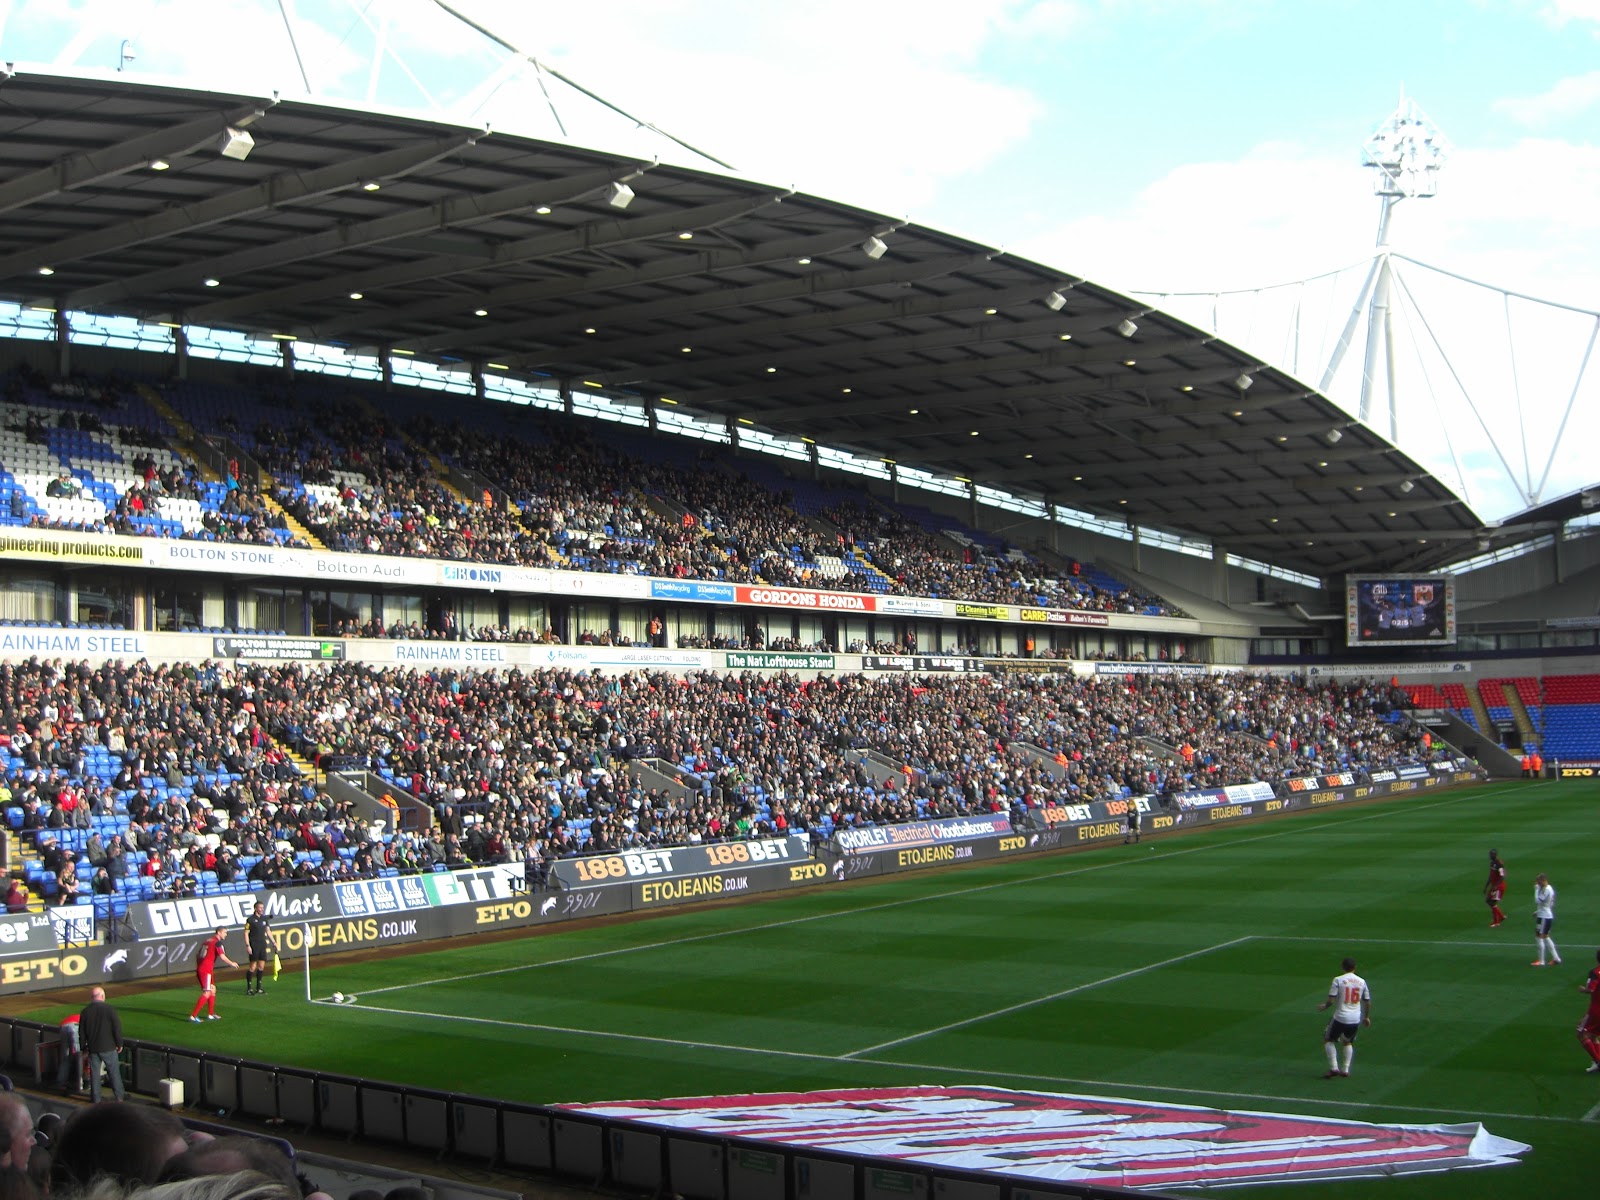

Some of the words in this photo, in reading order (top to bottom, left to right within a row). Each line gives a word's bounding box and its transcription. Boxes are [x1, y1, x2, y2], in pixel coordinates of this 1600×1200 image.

[62, 542, 143, 559] products.com
[170, 547, 226, 560] BOLTON
[231, 551, 274, 564] STONE
[317, 560, 368, 574] Bolton
[750, 589, 816, 607] GORDONS
[819, 594, 865, 610] HONDA
[965, 605, 987, 615] Cleaning
[988, 607, 998, 615] Ltd
[1021, 610, 1046, 621] CARRS
[1046, 612, 1066, 622] Pasties
[87, 637, 144, 653] STEEL
[230, 639, 266, 648] BOLTON
[268, 640, 321, 650] WANDERERS
[241, 648, 278, 658] AGAINST
[280, 649, 312, 658] RACISM
[396, 646, 461, 660] RAINHAM
[465, 647, 504, 662] STEEL
[728, 655, 747, 667] The
[749, 655, 763, 667] Nat
[765, 656, 808, 668] Lofthouse
[809, 657, 833, 668] Stand
[879, 657, 914, 667] WILSON
[932, 658, 965, 668] WILSON
[1562, 768, 1593, 777] ETO
[1106, 797, 1152, 816] 188ET
[1265, 800, 1282, 811] ETO
[1041, 804, 1093, 824] 188BET
[1153, 815, 1173, 828] ETO
[840, 827, 889, 848] CHORLEY
[890, 825, 931, 843] Electrical
[1000, 836, 1026, 851] ETO
[706, 838, 790, 867] 188BET
[575, 851, 673, 881] 188BET
[790, 863, 827, 881] ETO
[267, 891, 323, 917] Mart
[344, 904, 367, 915] YARA
[376, 901, 397, 911] YARA
[406, 897, 427, 907] YARA
[476, 901, 532, 924] ETO
[31, 915, 50, 927] Ltd
[2, 954, 88, 985] ETO
[1344, 986, 1361, 1004] 16
